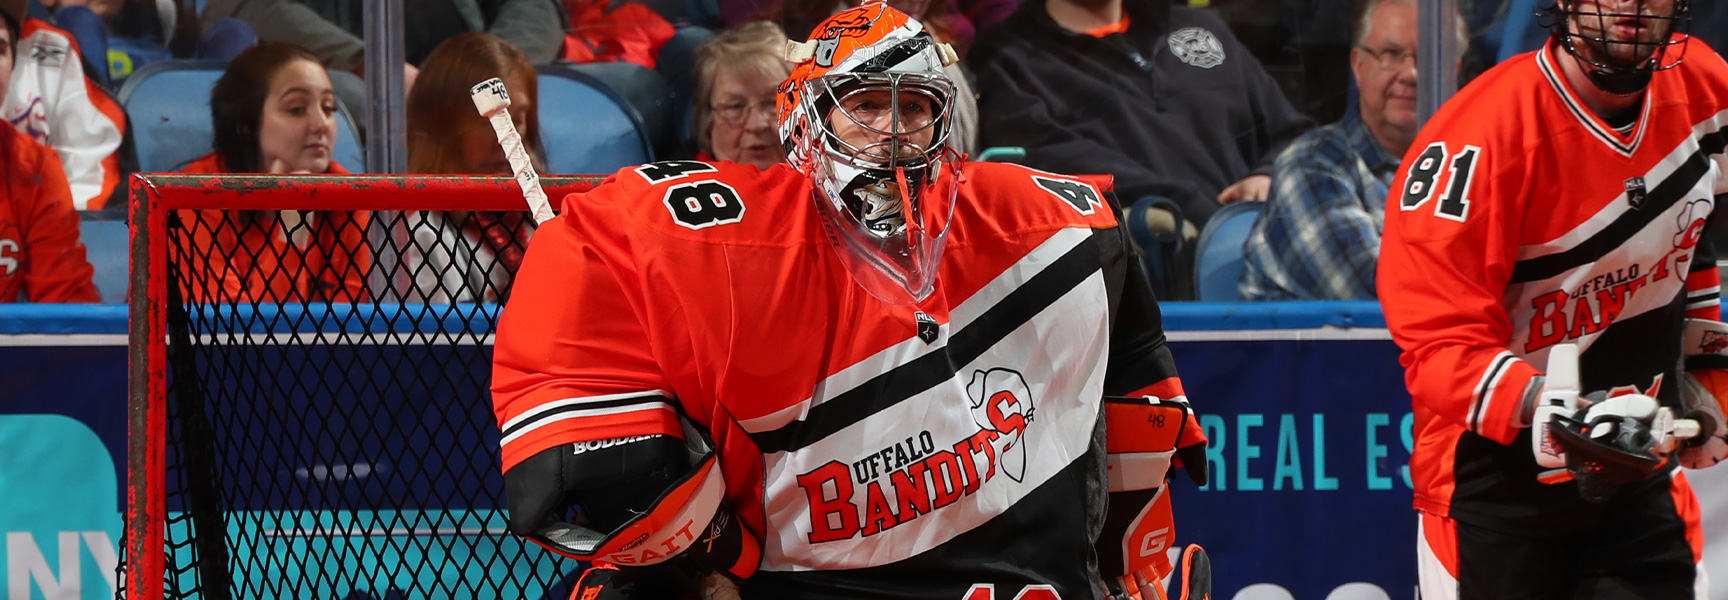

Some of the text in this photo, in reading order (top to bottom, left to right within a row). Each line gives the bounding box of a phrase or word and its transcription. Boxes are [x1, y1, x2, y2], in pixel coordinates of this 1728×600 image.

[633, 159, 747, 231] 48
[1029, 174, 1104, 217] 4
[1400, 141, 1482, 222] 81
[916, 312, 936, 323] NLL
[1147, 414, 1166, 428] 48
[796, 390, 1027, 545] BANDITS
[1198, 413, 1339, 492] REAL
[610, 518, 695, 565] GAIT
